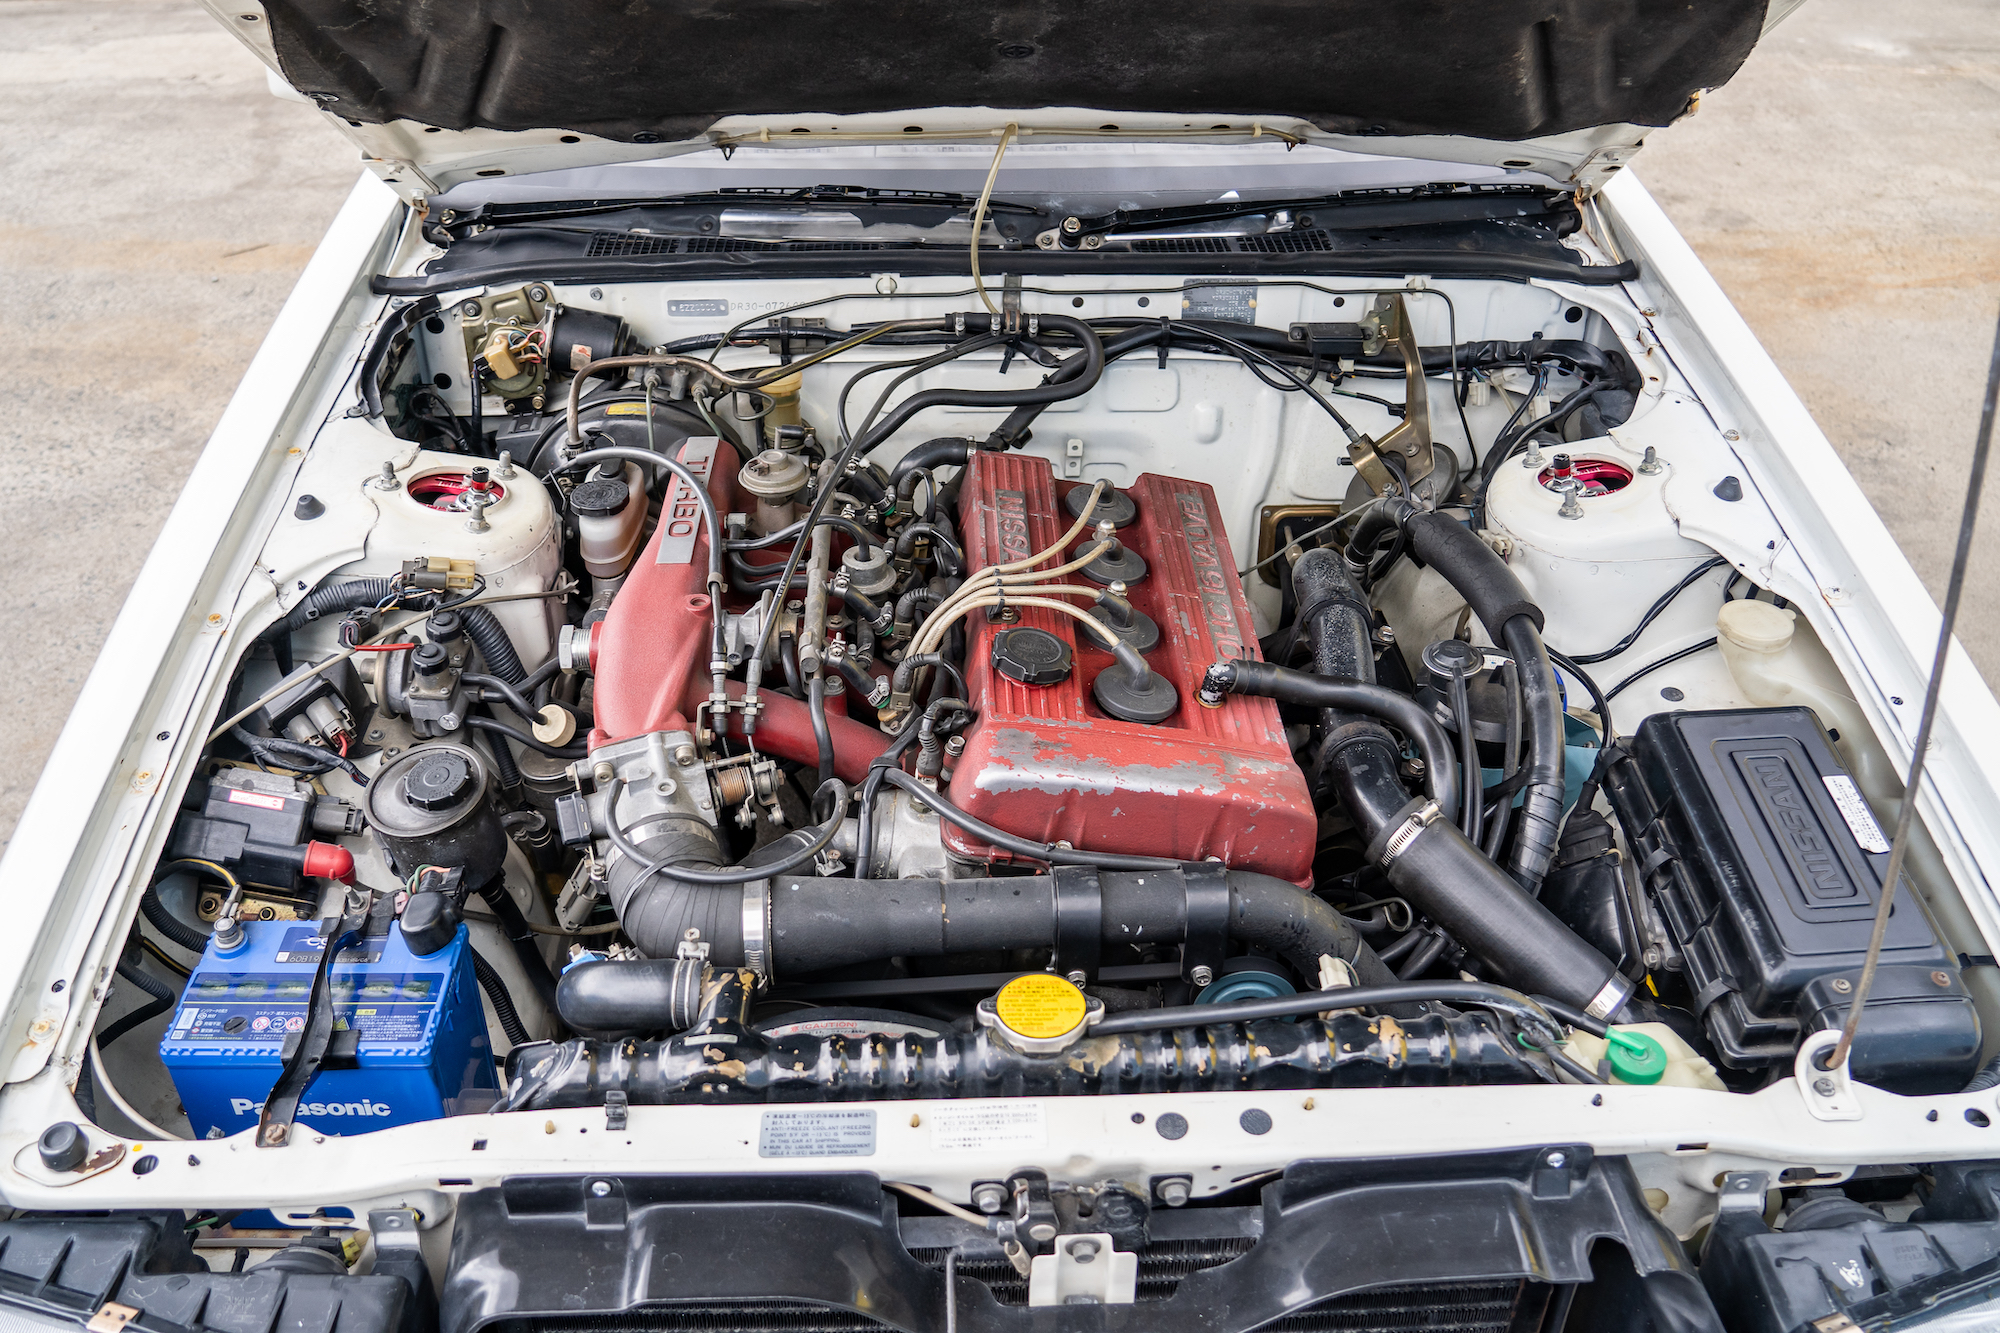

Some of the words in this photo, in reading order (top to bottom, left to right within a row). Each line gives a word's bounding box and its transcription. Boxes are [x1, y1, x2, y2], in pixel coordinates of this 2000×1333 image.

[998, 496, 1030, 573] NISSA
[1206, 601, 1243, 664] OHC
[1755, 764, 1843, 890] NISSAN
[289, 955, 321, 963] 60B19
[801, 1021, 858, 1032] (CAUTION)
[230, 1098, 391, 1117] Paasonic
